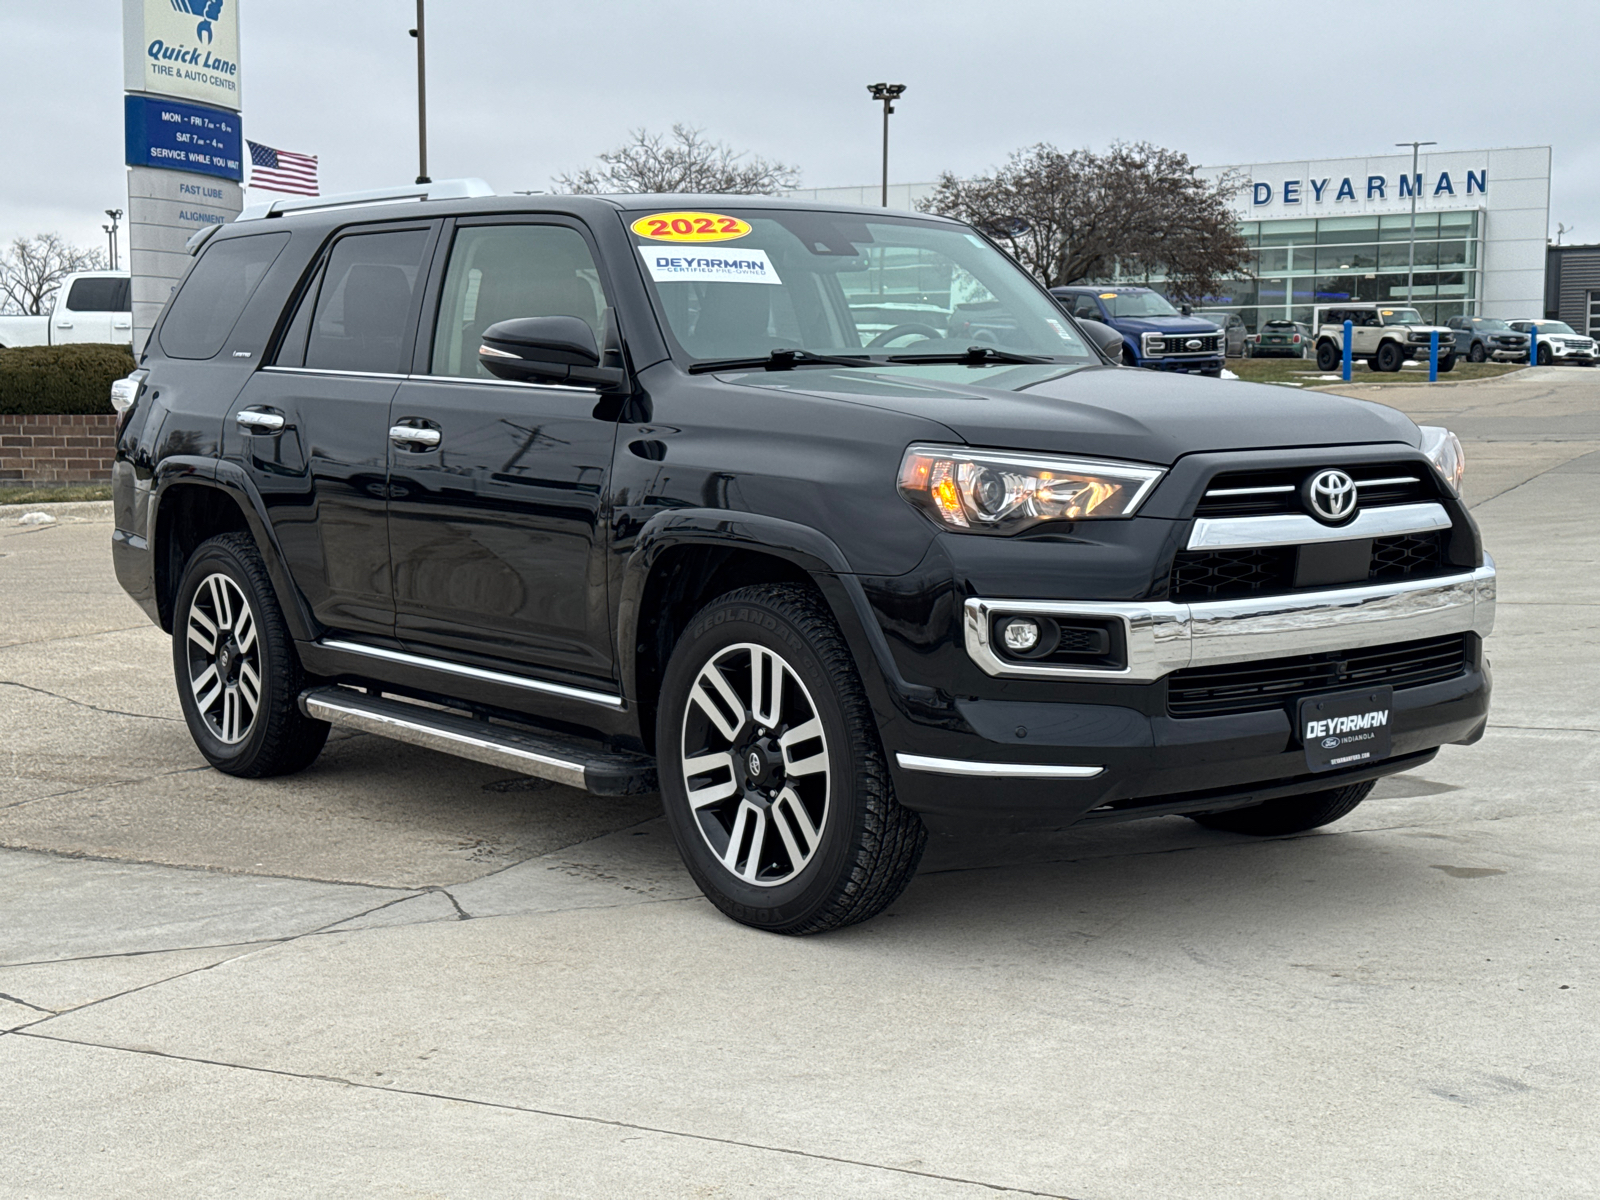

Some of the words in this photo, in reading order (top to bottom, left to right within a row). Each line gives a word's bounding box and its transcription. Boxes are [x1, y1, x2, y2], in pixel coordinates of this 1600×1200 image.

[148, 39, 202, 66] Quick
[203, 51, 236, 76] Lane
[151, 63, 174, 76] TIRE
[176, 68, 182, 78] &
[184, 70, 208, 83] AUTO
[209, 75, 236, 91] CENTER
[162, 111, 181, 123] MON
[190, 116, 202, 126] FRI
[176, 132, 191, 142] SAT
[150, 147, 186, 160] SERVICE
[188, 152, 210, 164] WHILE
[212, 156, 225, 167] YOU
[226, 159, 239, 169] WAIT
[180, 183, 201, 195] FAST
[203, 187, 223, 199] LUBE
[1253, 168, 1488, 206] DEYARMAN
[179, 210, 225, 224] ALIGNMENT
[647, 218, 742, 236] 2022
[656, 257, 765, 271] DEYARMAN
[716, 268, 766, 276] PRE-OWNED
[694, 608, 803, 653] GEOLANDAR
[1306, 710, 1389, 739] DEYARMAN
[1341, 732, 1375, 744] INDIANOLA
